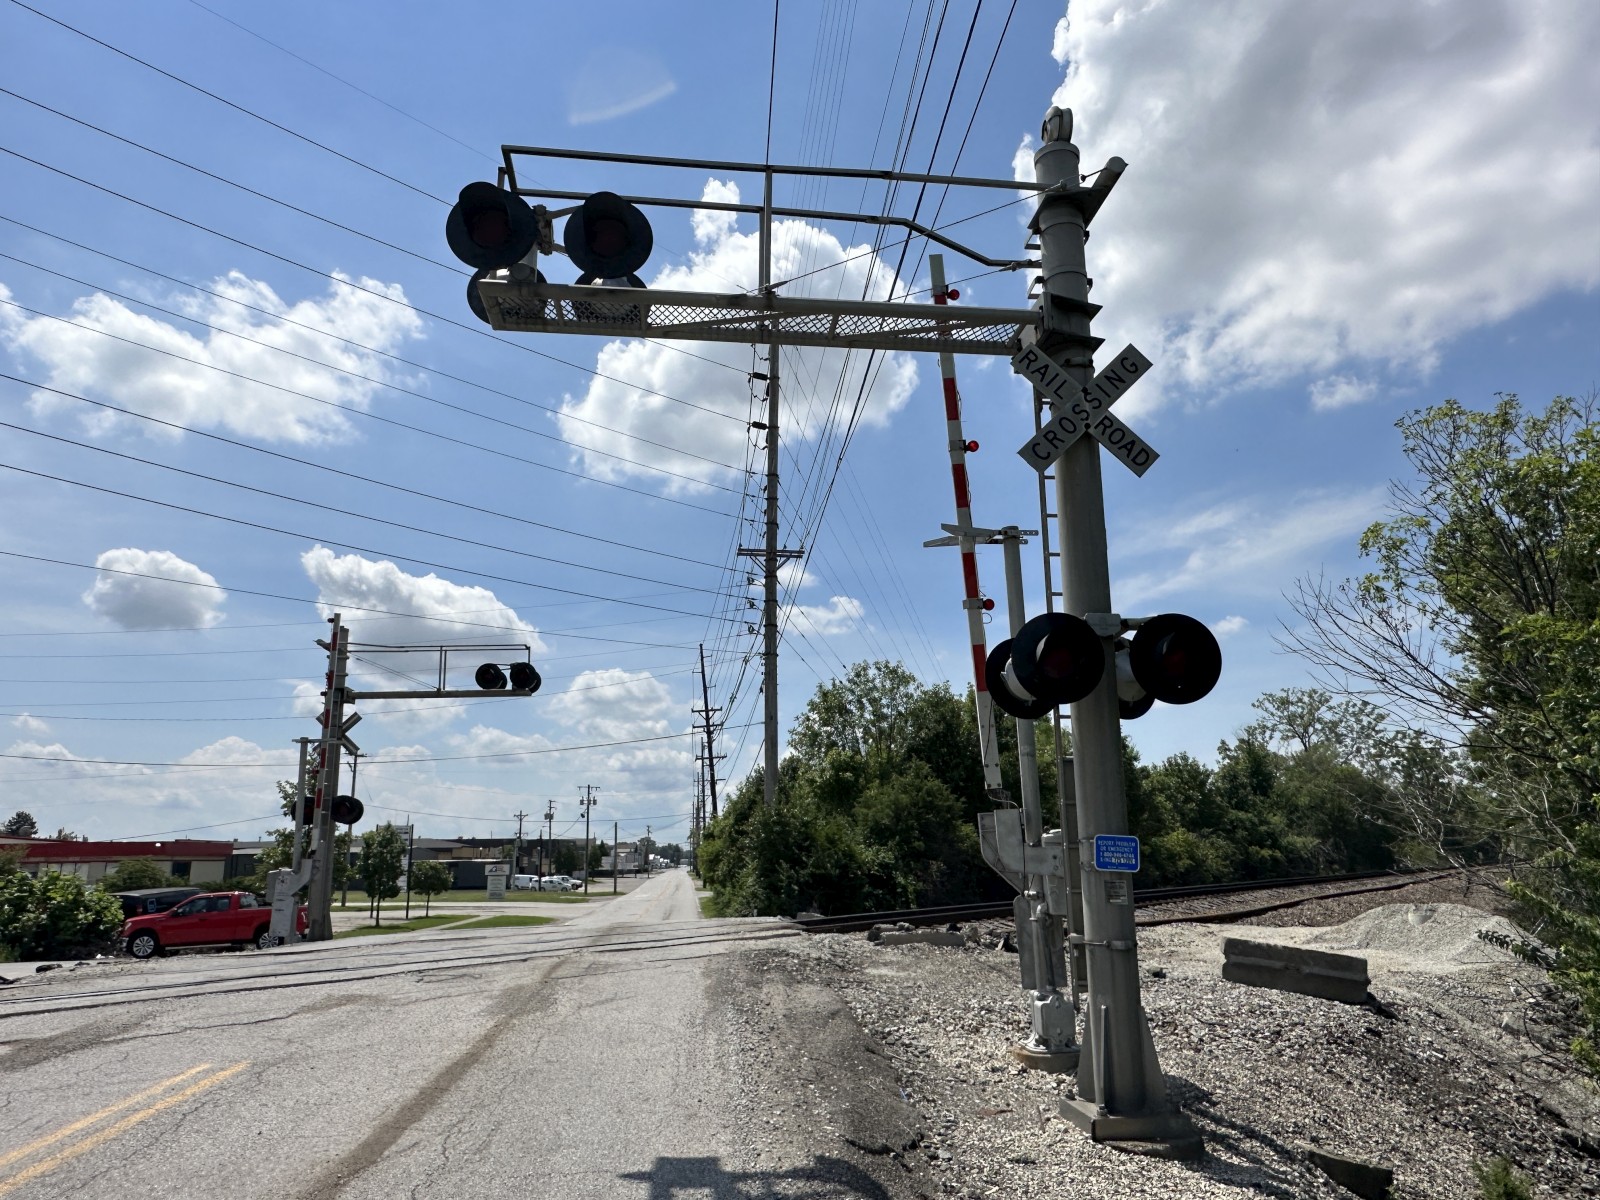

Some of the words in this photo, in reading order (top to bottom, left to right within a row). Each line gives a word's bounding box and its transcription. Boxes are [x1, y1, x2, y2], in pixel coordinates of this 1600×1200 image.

[1018, 349, 1067, 400] RAIL
[1094, 415, 1150, 467] ROAD
[1031, 356, 1139, 460] CROSSING
